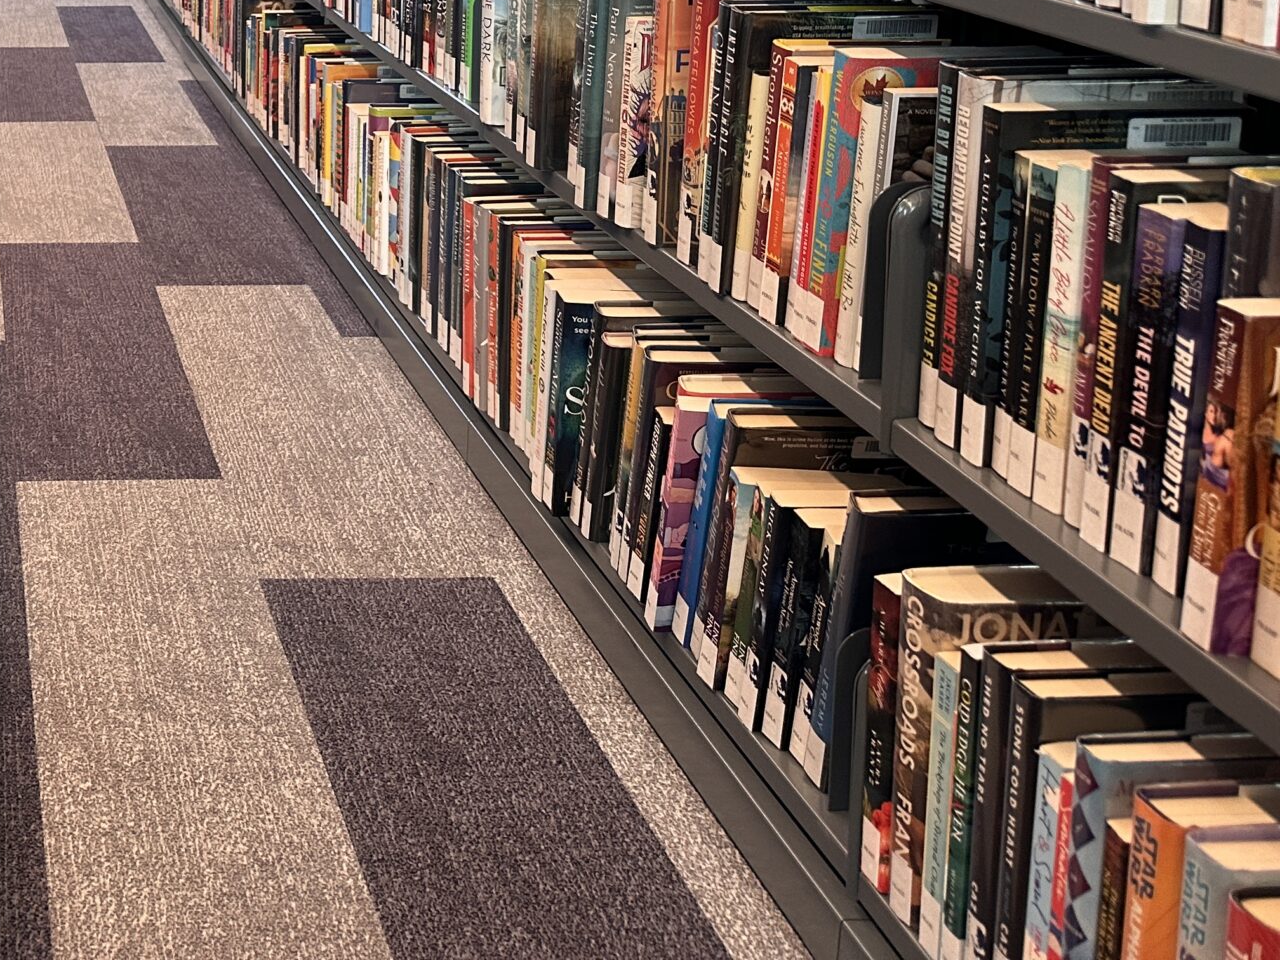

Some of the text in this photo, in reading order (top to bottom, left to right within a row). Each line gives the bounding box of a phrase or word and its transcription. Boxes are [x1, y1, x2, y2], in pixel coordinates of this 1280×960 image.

[584, 43, 598, 87] Living
[606, 7, 620, 97] Paris Never
[761, 51, 784, 162] Strongheart
[825, 110, 840, 178] FERGUSON
[922, 84, 953, 341] GONE MIDNIGHT CANDICE
[939, 103, 971, 377] REDEMPTION POINT CANDICE FOX
[1052, 216, 1076, 263] Little
[969, 173, 991, 378] LULLABY WITCHES
[1005, 240, 1019, 304] ORPHAN
[1025, 252, 1041, 318] WIDOW
[1137, 228, 1155, 307] FRADKIN
[1150, 231, 1167, 311] BARBARA
[1187, 248, 1206, 313] RUSSELL
[538, 297, 550, 373] Perfect Kill
[572, 315, 588, 324] You
[1091, 280, 1121, 434] THE ANCIENT DEAD
[1212, 317, 1235, 394] FRAMPTON
[1131, 325, 1154, 416] THE DEVIL
[643, 416, 662, 500] JOSEPH FINDER
[1159, 334, 1196, 513] TRUE PATRIOTS
[757, 501, 776, 597] MICK FINLAY
[897, 595, 924, 770] CROSSROADS
[932, 750, 948, 805] Bookshop
[976, 673, 993, 804] SHED TEARS
[1004, 704, 1026, 869] STONE COLD HEART
[1037, 764, 1061, 828] Heart
[1128, 815, 1145, 898] WARS
[1138, 822, 1159, 900] STAR
[1181, 860, 1197, 940] WARS
[1190, 869, 1210, 947] STAR
